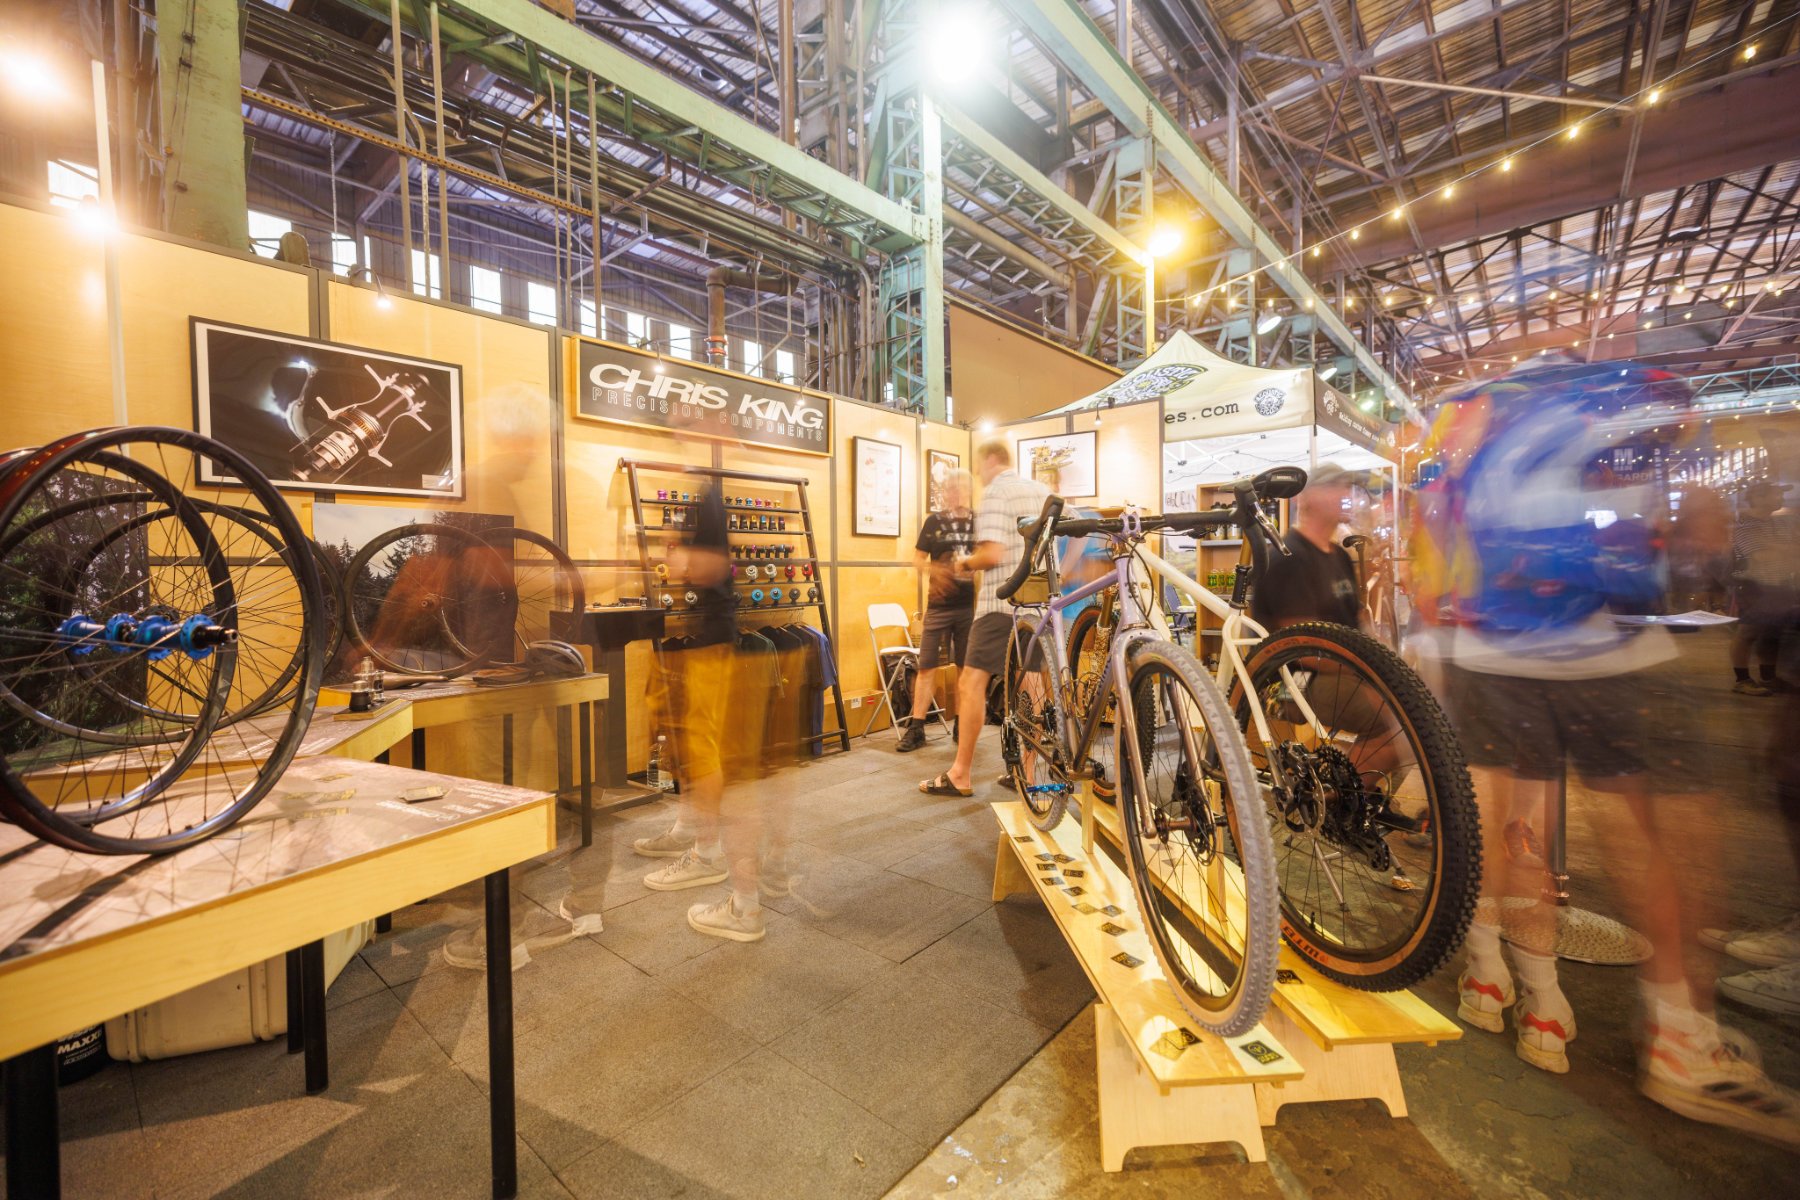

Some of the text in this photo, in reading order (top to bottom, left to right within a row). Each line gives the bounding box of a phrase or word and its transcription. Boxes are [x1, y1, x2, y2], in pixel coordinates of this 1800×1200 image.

[589, 363, 728, 409] CHRIS
[592, 386, 823, 442] PRECISION COMPONENTS
[1282, 925, 1320, 959] WTB
